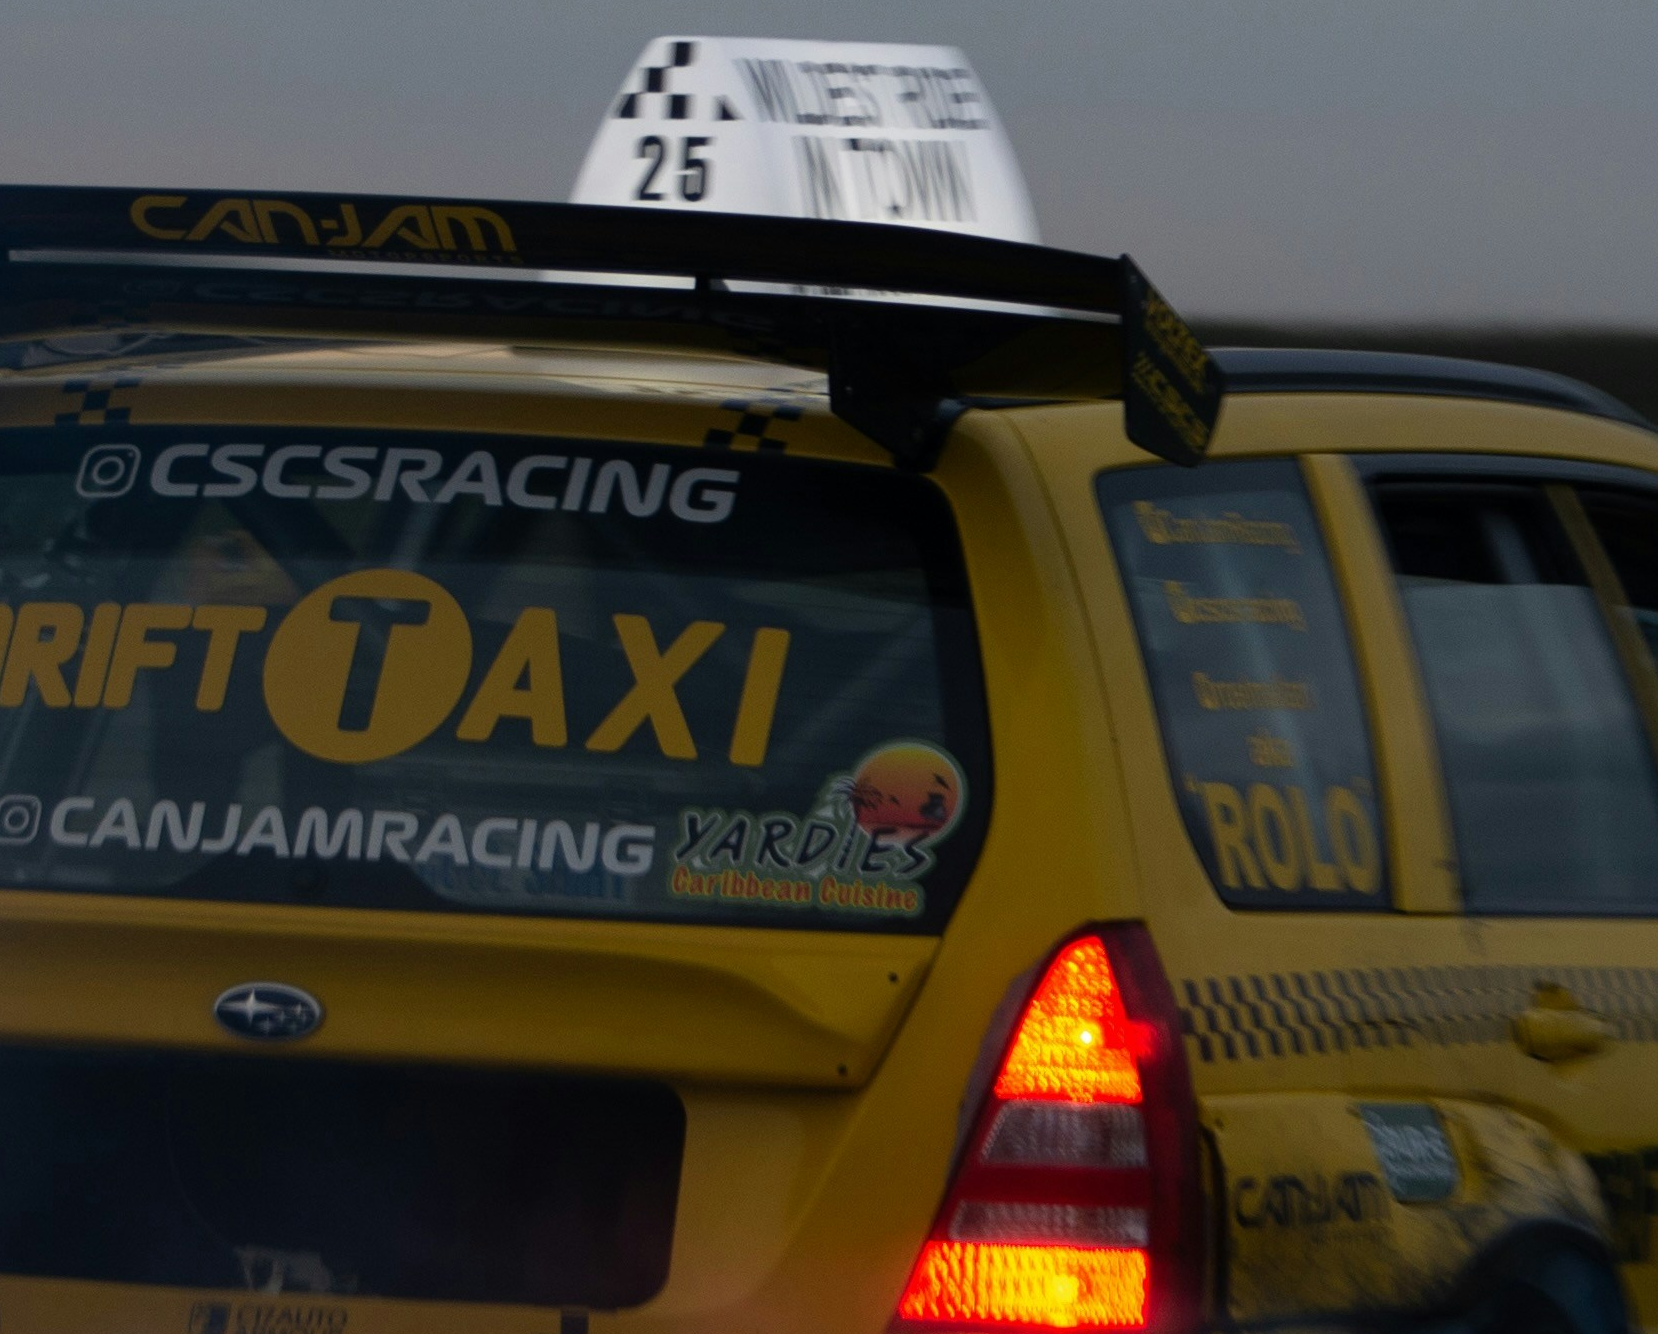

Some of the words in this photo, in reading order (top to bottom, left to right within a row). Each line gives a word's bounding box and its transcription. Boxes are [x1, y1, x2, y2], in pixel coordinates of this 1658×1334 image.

[635, 135, 707, 201] 25
[129, 195, 518, 252] CAN-JAM
[149, 443, 741, 524] CSCSRACING
[48, 796, 657, 876] CANJAMRACING
[674, 811, 934, 876] YARDIES
[672, 866, 813, 905] Caribbean
[818, 874, 919, 912] Cuisine
